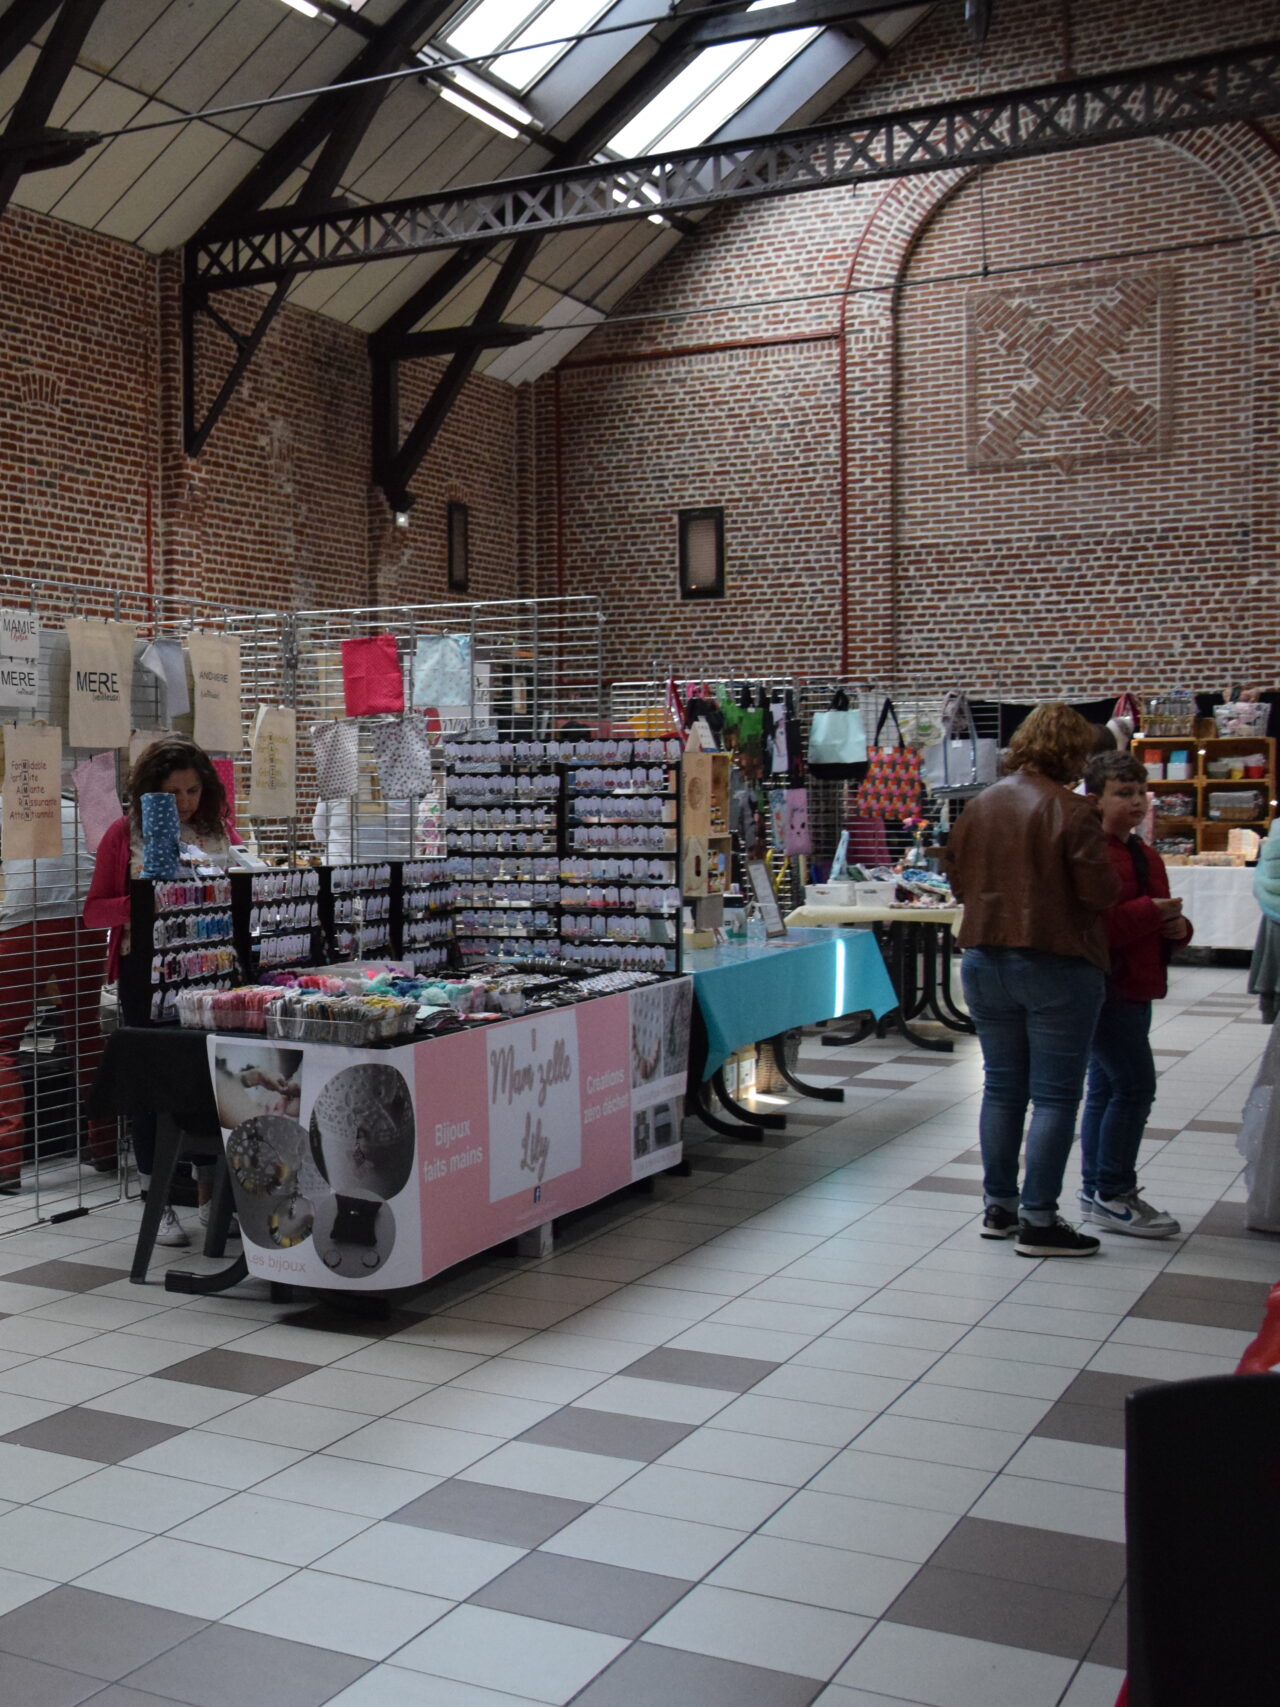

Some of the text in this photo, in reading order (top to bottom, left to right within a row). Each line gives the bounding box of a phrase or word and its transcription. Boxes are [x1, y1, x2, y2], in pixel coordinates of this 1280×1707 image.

[3, 618, 37, 635] MAMIE
[1, 670, 36, 687] MERE
[76, 671, 119, 693] MERE
[434, 1120, 471, 1149] Bijoux
[423, 1146, 484, 1184] faits mains
[268, 1255, 307, 1273] bijoux
